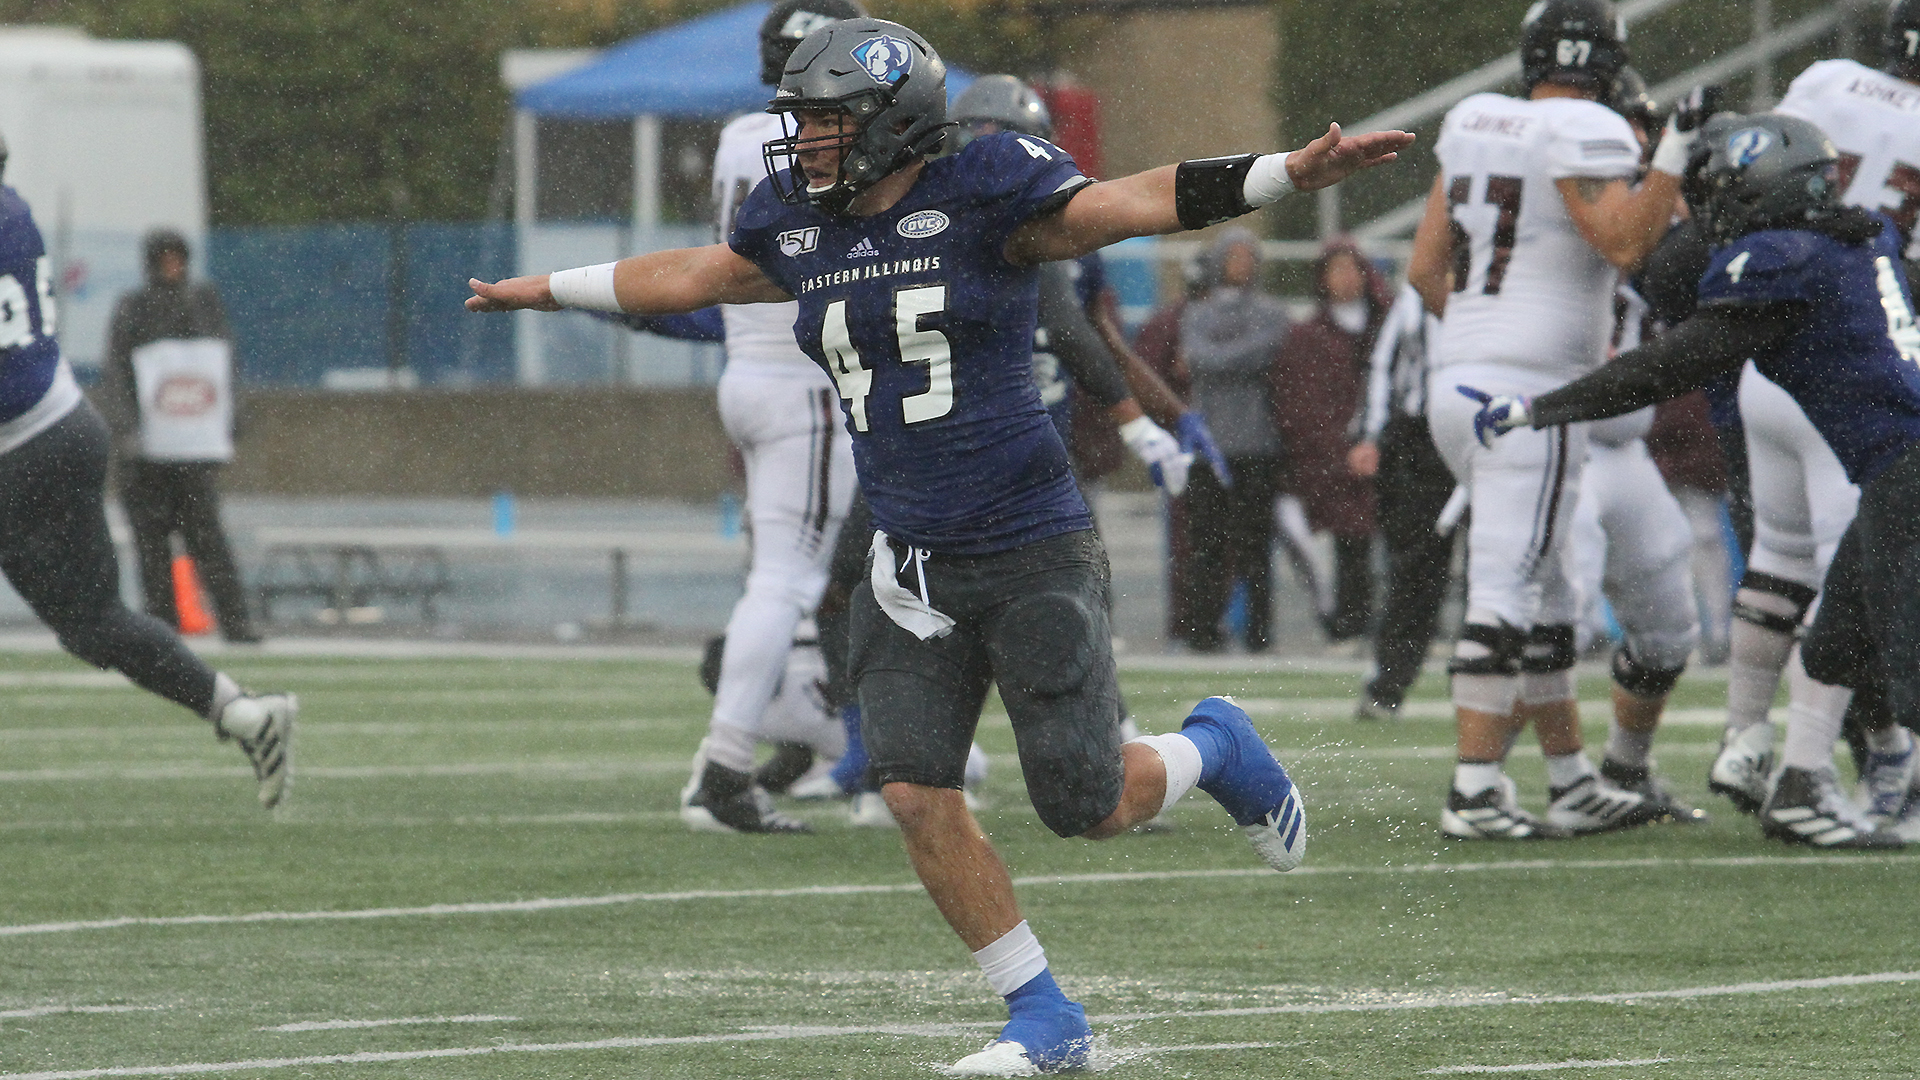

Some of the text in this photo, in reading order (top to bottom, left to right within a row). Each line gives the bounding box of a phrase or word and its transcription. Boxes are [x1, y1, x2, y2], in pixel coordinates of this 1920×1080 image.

[1555, 38, 1593, 67] 67
[776, 226, 820, 258] 150
[847, 249, 880, 260] adidas
[801, 256, 942, 294] EASTERN ILLINOIS
[1725, 251, 1751, 285] 4
[821, 286, 954, 433] 45
